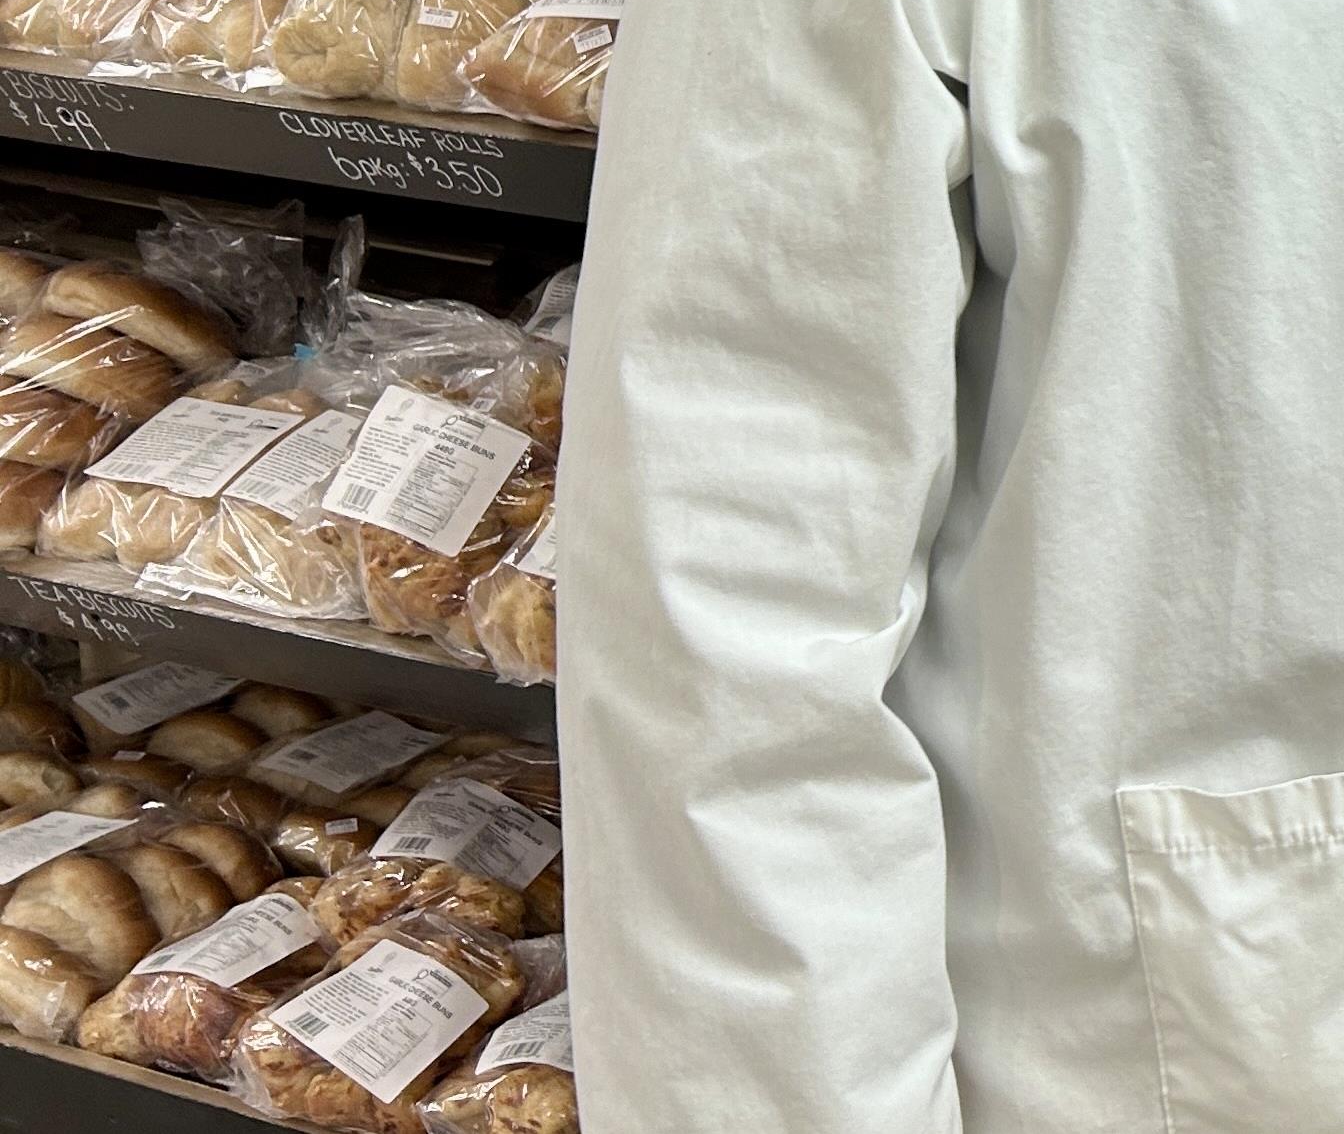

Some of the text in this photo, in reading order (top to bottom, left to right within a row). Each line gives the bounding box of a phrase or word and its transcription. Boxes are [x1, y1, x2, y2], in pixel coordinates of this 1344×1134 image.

[8, 71, 135, 111] BISCUITS:
[9, 98, 111, 152] $4.99
[277, 109, 505, 160] CLOVERLEAF ROLLS
[406, 151, 503, 198] $3.50
[14, 576, 177, 631] TEA BISCUITS
[56, 605, 140, 647] $4.99
